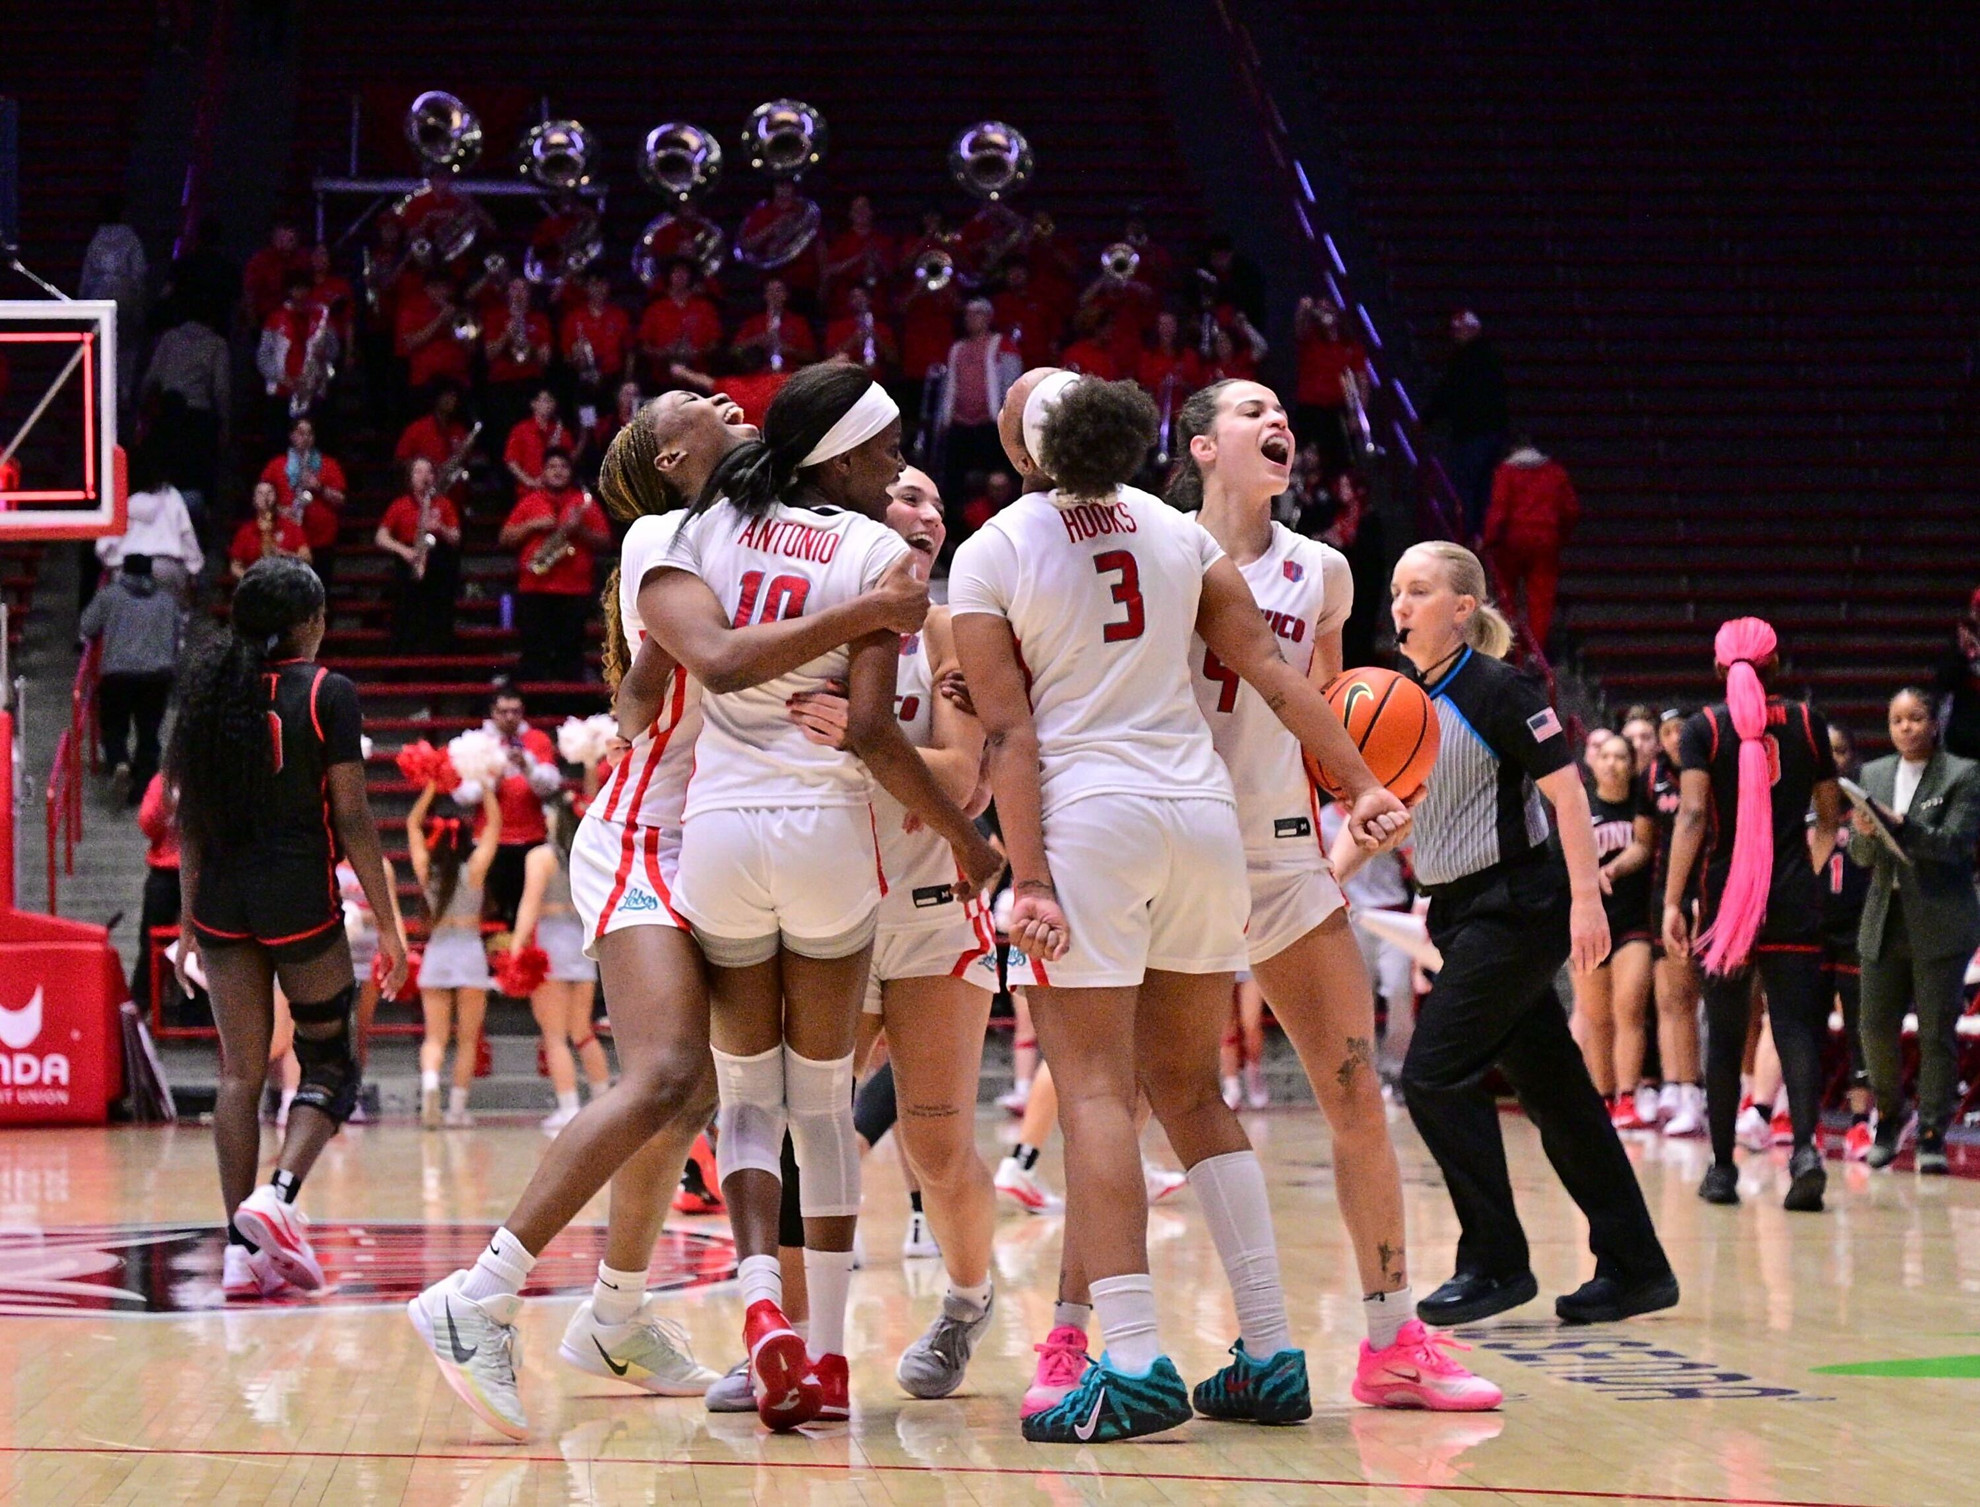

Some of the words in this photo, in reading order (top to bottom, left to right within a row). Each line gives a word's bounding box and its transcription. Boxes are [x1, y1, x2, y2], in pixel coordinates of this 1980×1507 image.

[737, 513, 840, 565] ANTONIO
[1060, 501, 1138, 544] HOOKS
[732, 569, 812, 630] 10
[1092, 548, 1146, 644] 3
[617, 887, 659, 912] Lobos
[16, 1088, 70, 1106] UNION
